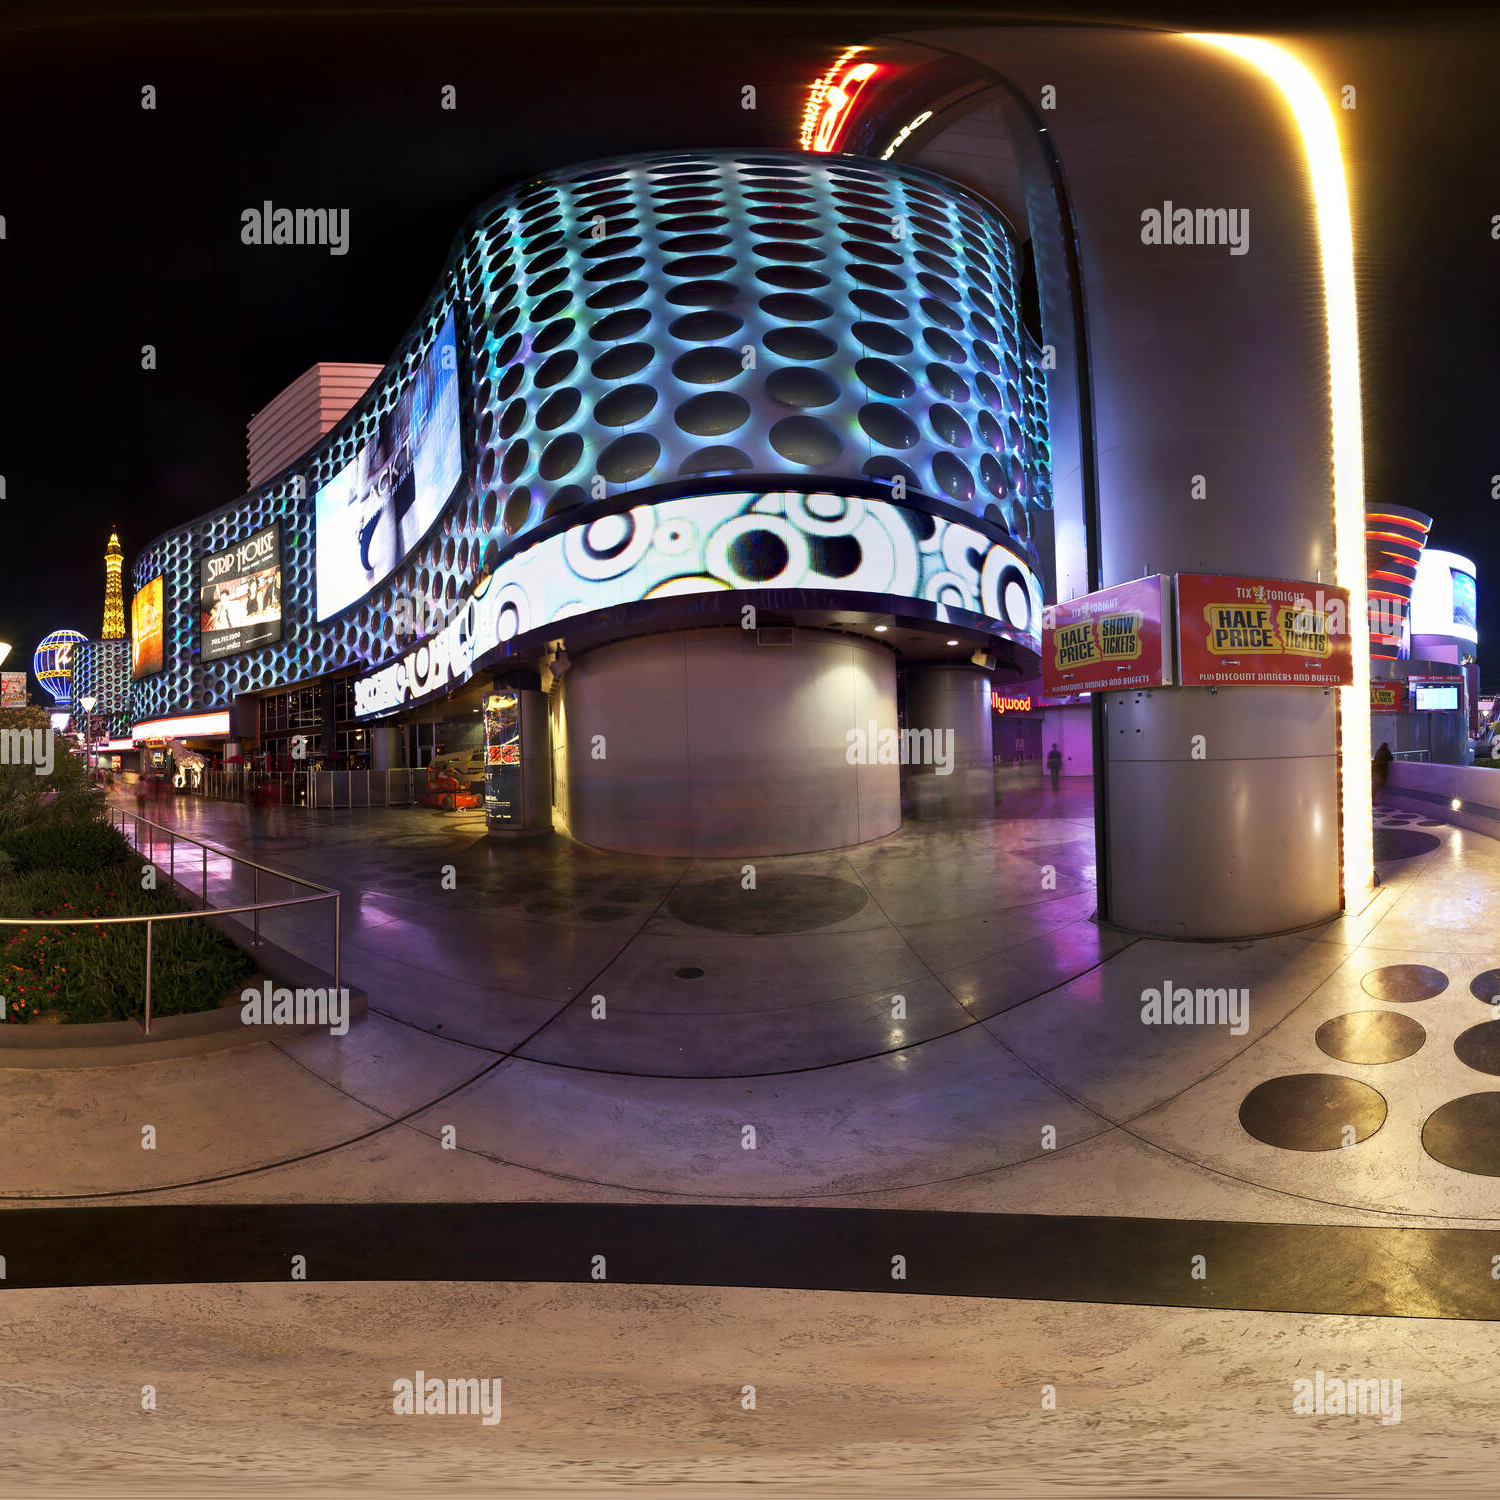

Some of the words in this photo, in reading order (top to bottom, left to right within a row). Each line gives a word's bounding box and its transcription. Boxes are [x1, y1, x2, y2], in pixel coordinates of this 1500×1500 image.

[207, 553, 235, 583] STRIP
[236, 531, 274, 573] HOUSE
[1236, 587, 1252, 599] TIX
[1265, 589, 1305, 603] TONIGHT
[1061, 625, 1091, 649] HALF
[1102, 616, 1134, 637] SHOW
[1218, 610, 1268, 629] HALF
[1284, 612, 1325, 633] SHOW
[1059, 641, 1095, 665] PRICE
[1102, 635, 1136, 655] TICKETS
[1216, 629, 1274, 648] PRICE
[1285, 629, 1326, 652] TICKETS
[1061, 682, 1084, 692] DISCOUNT
[1085, 680, 1108, 689] DINNERS
[1109, 677, 1122, 686] AND
[1123, 675, 1150, 685] BUFFETS
[1199, 673, 1215, 681] PLUS
[1215, 672, 1256, 681] DISCOUNT
[1258, 672, 1292, 682] DINNERS
[1293, 673, 1311, 682] AND
[1311, 674, 1341, 683] BUFFETS
[990, 691, 1031, 714] llywood
